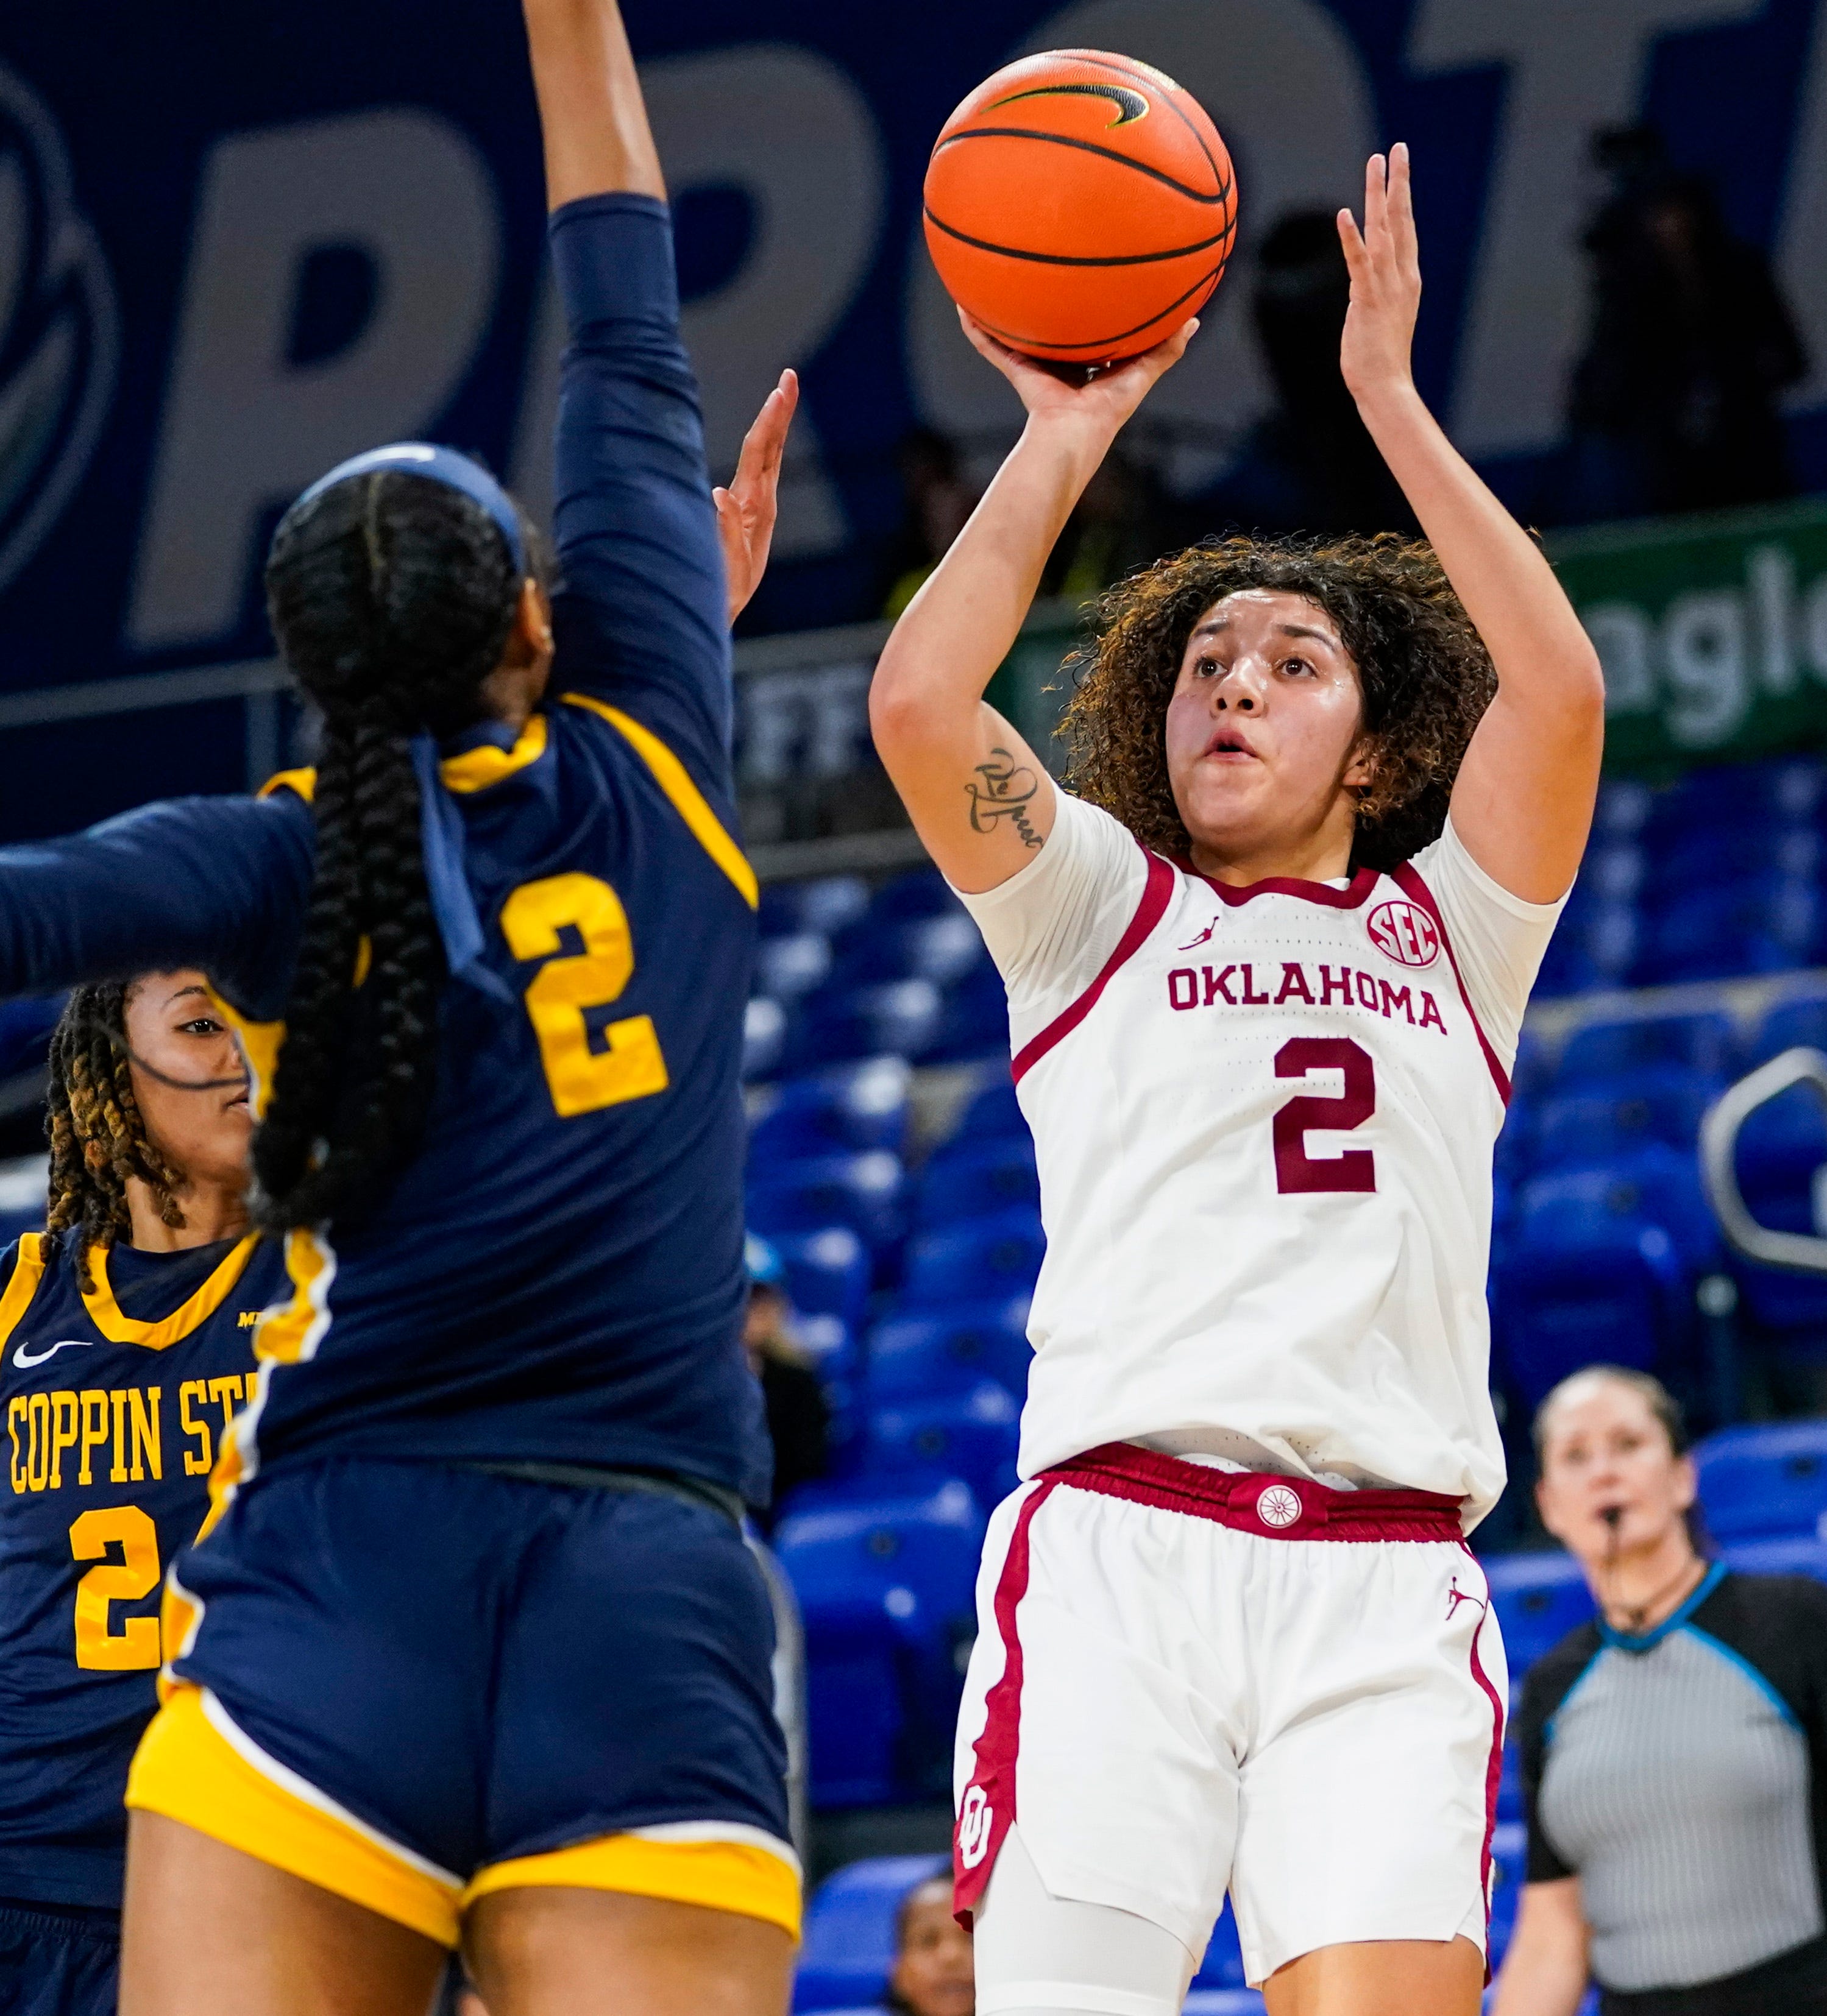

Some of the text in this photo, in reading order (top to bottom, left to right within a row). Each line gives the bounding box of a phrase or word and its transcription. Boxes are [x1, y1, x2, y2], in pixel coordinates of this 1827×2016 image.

[500, 871, 669, 1118] 2
[1370, 900, 1438, 964] SEC
[1168, 962, 1448, 1036] OKLAHOMA
[1272, 1037, 1377, 1194] 2
[9, 1386, 162, 1494] COPPIN
[69, 1505, 161, 1671] 2
